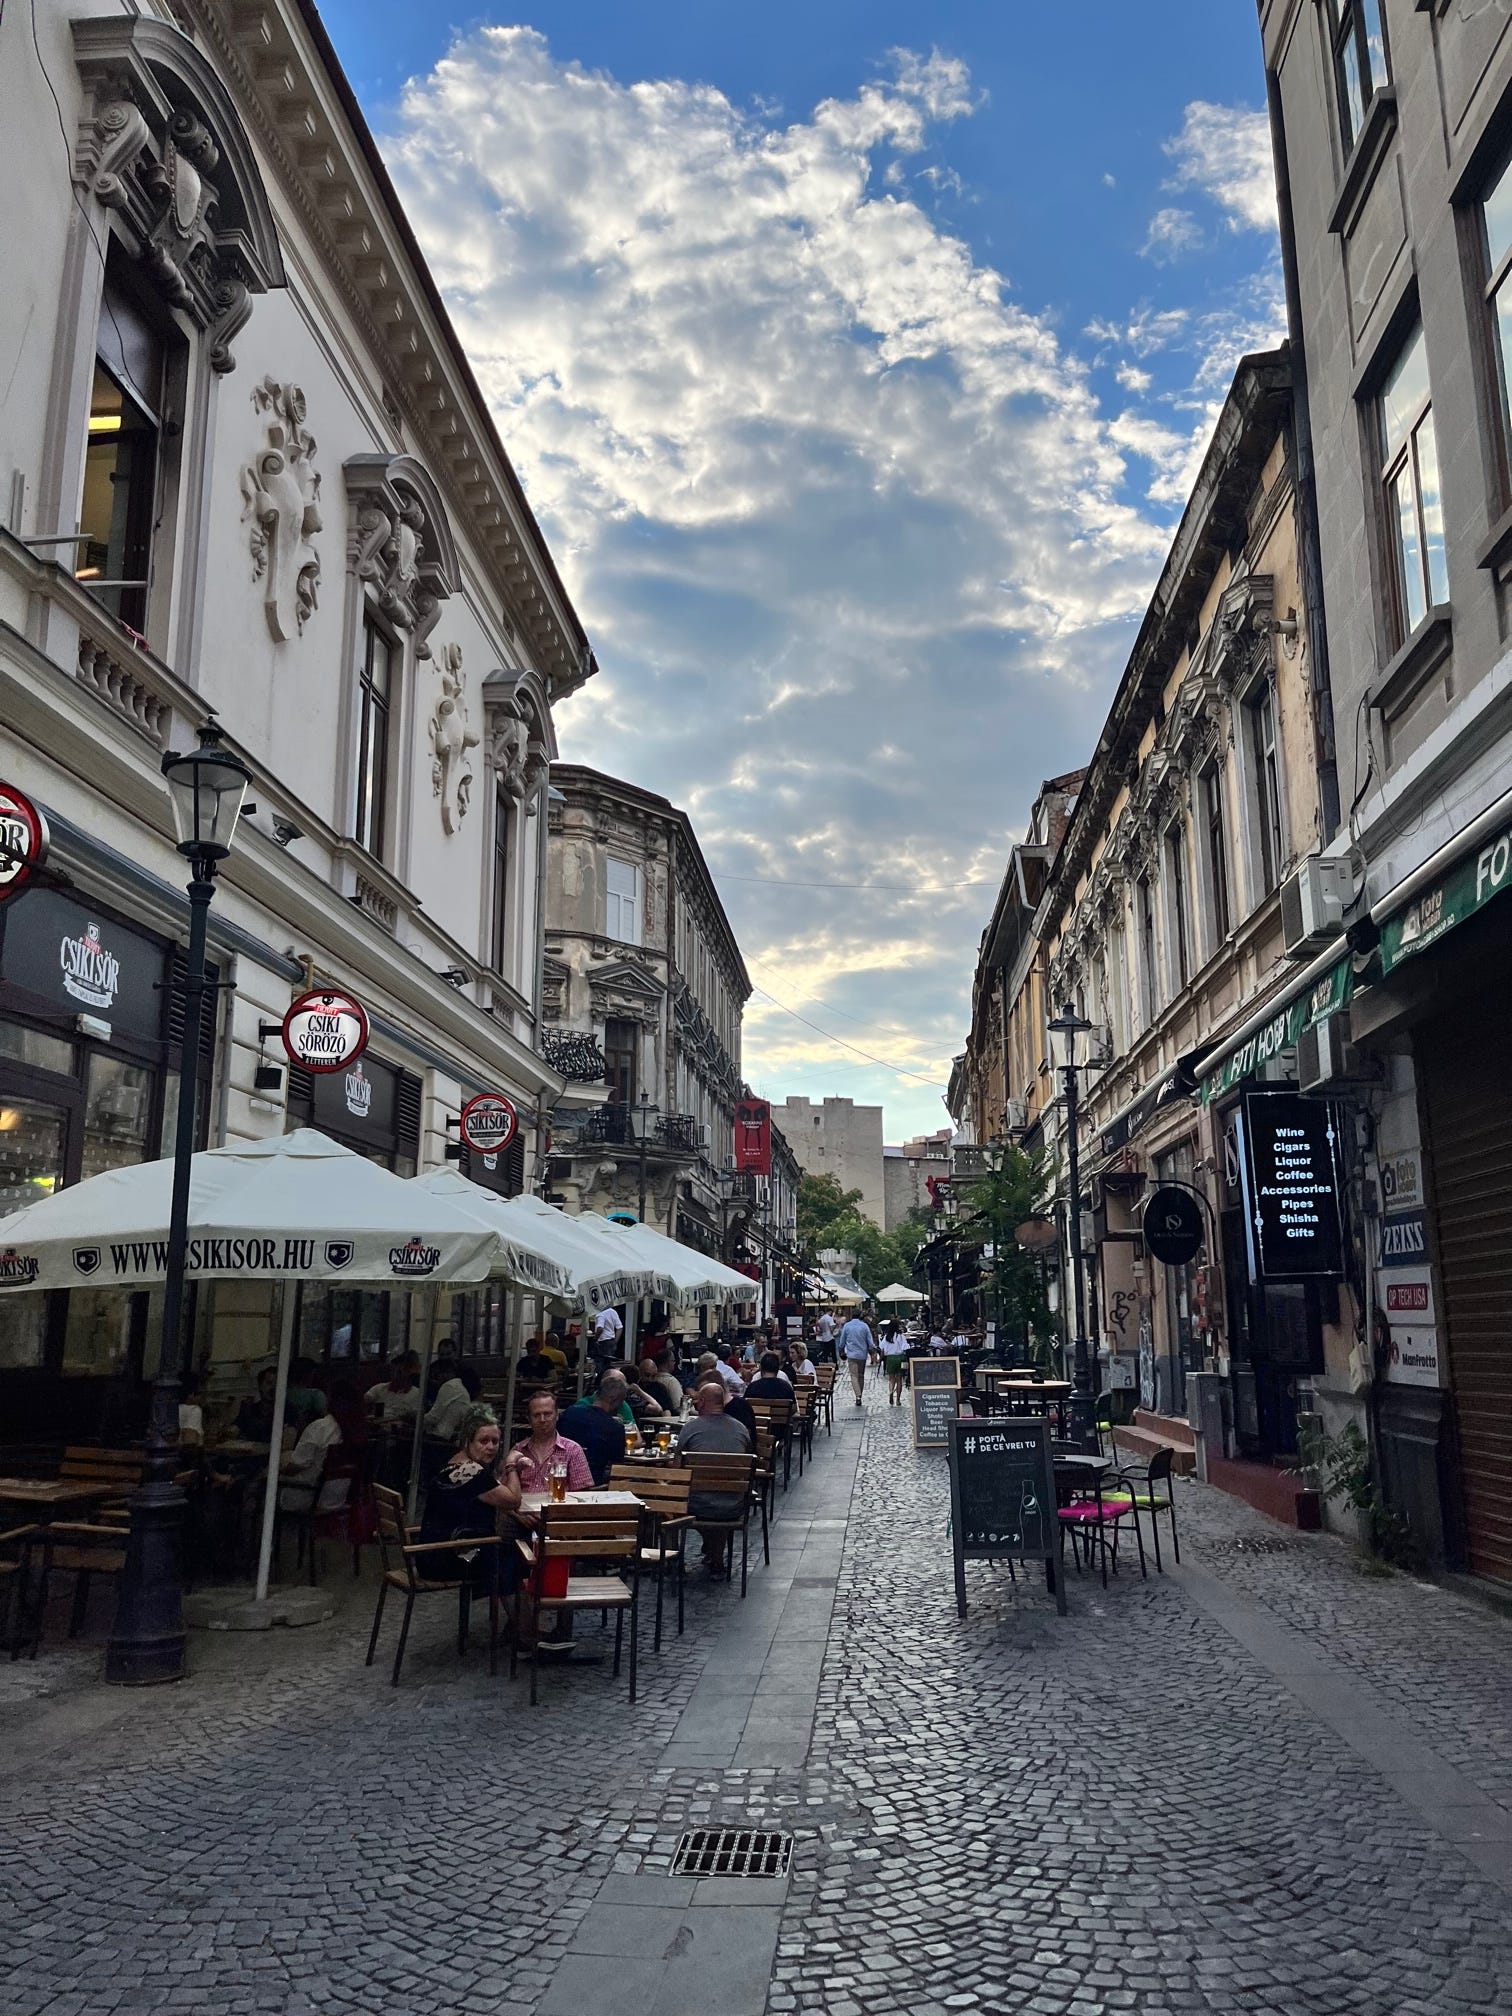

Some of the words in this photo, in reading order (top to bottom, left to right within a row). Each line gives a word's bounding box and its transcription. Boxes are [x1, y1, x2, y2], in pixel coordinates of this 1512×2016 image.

[1476, 830, 1512, 902] FO
[1257, 1006, 1294, 1063] HOBBY
[298, 1031, 346, 1054] SÖRÖZŐ
[1275, 1128, 1305, 1137] Wine
[1273, 1142, 1311, 1153] Cigars
[1275, 1157, 1312, 1167] Liquor
[1276, 1171, 1314, 1180] Coffee
[1261, 1184, 1332, 1195] Accessories
[1281, 1200, 1314, 1210] Pipes
[1279, 1214, 1319, 1224] Shisha
[1286, 1228, 1315, 1238] Gifts
[1383, 1221, 1425, 1255] ZEISS
[1388, 1289, 1397, 1307] OP
[1398, 1288, 1412, 1306] TECH
[1413, 1288, 1427, 1305] USA
[1402, 1353, 1437, 1368] Manfrotto
[980, 1443, 991, 1452] DE
[992, 1442, 1004, 1451] CE
[1005, 1440, 1024, 1450] VREI
[1025, 1440, 1036, 1448] TU
